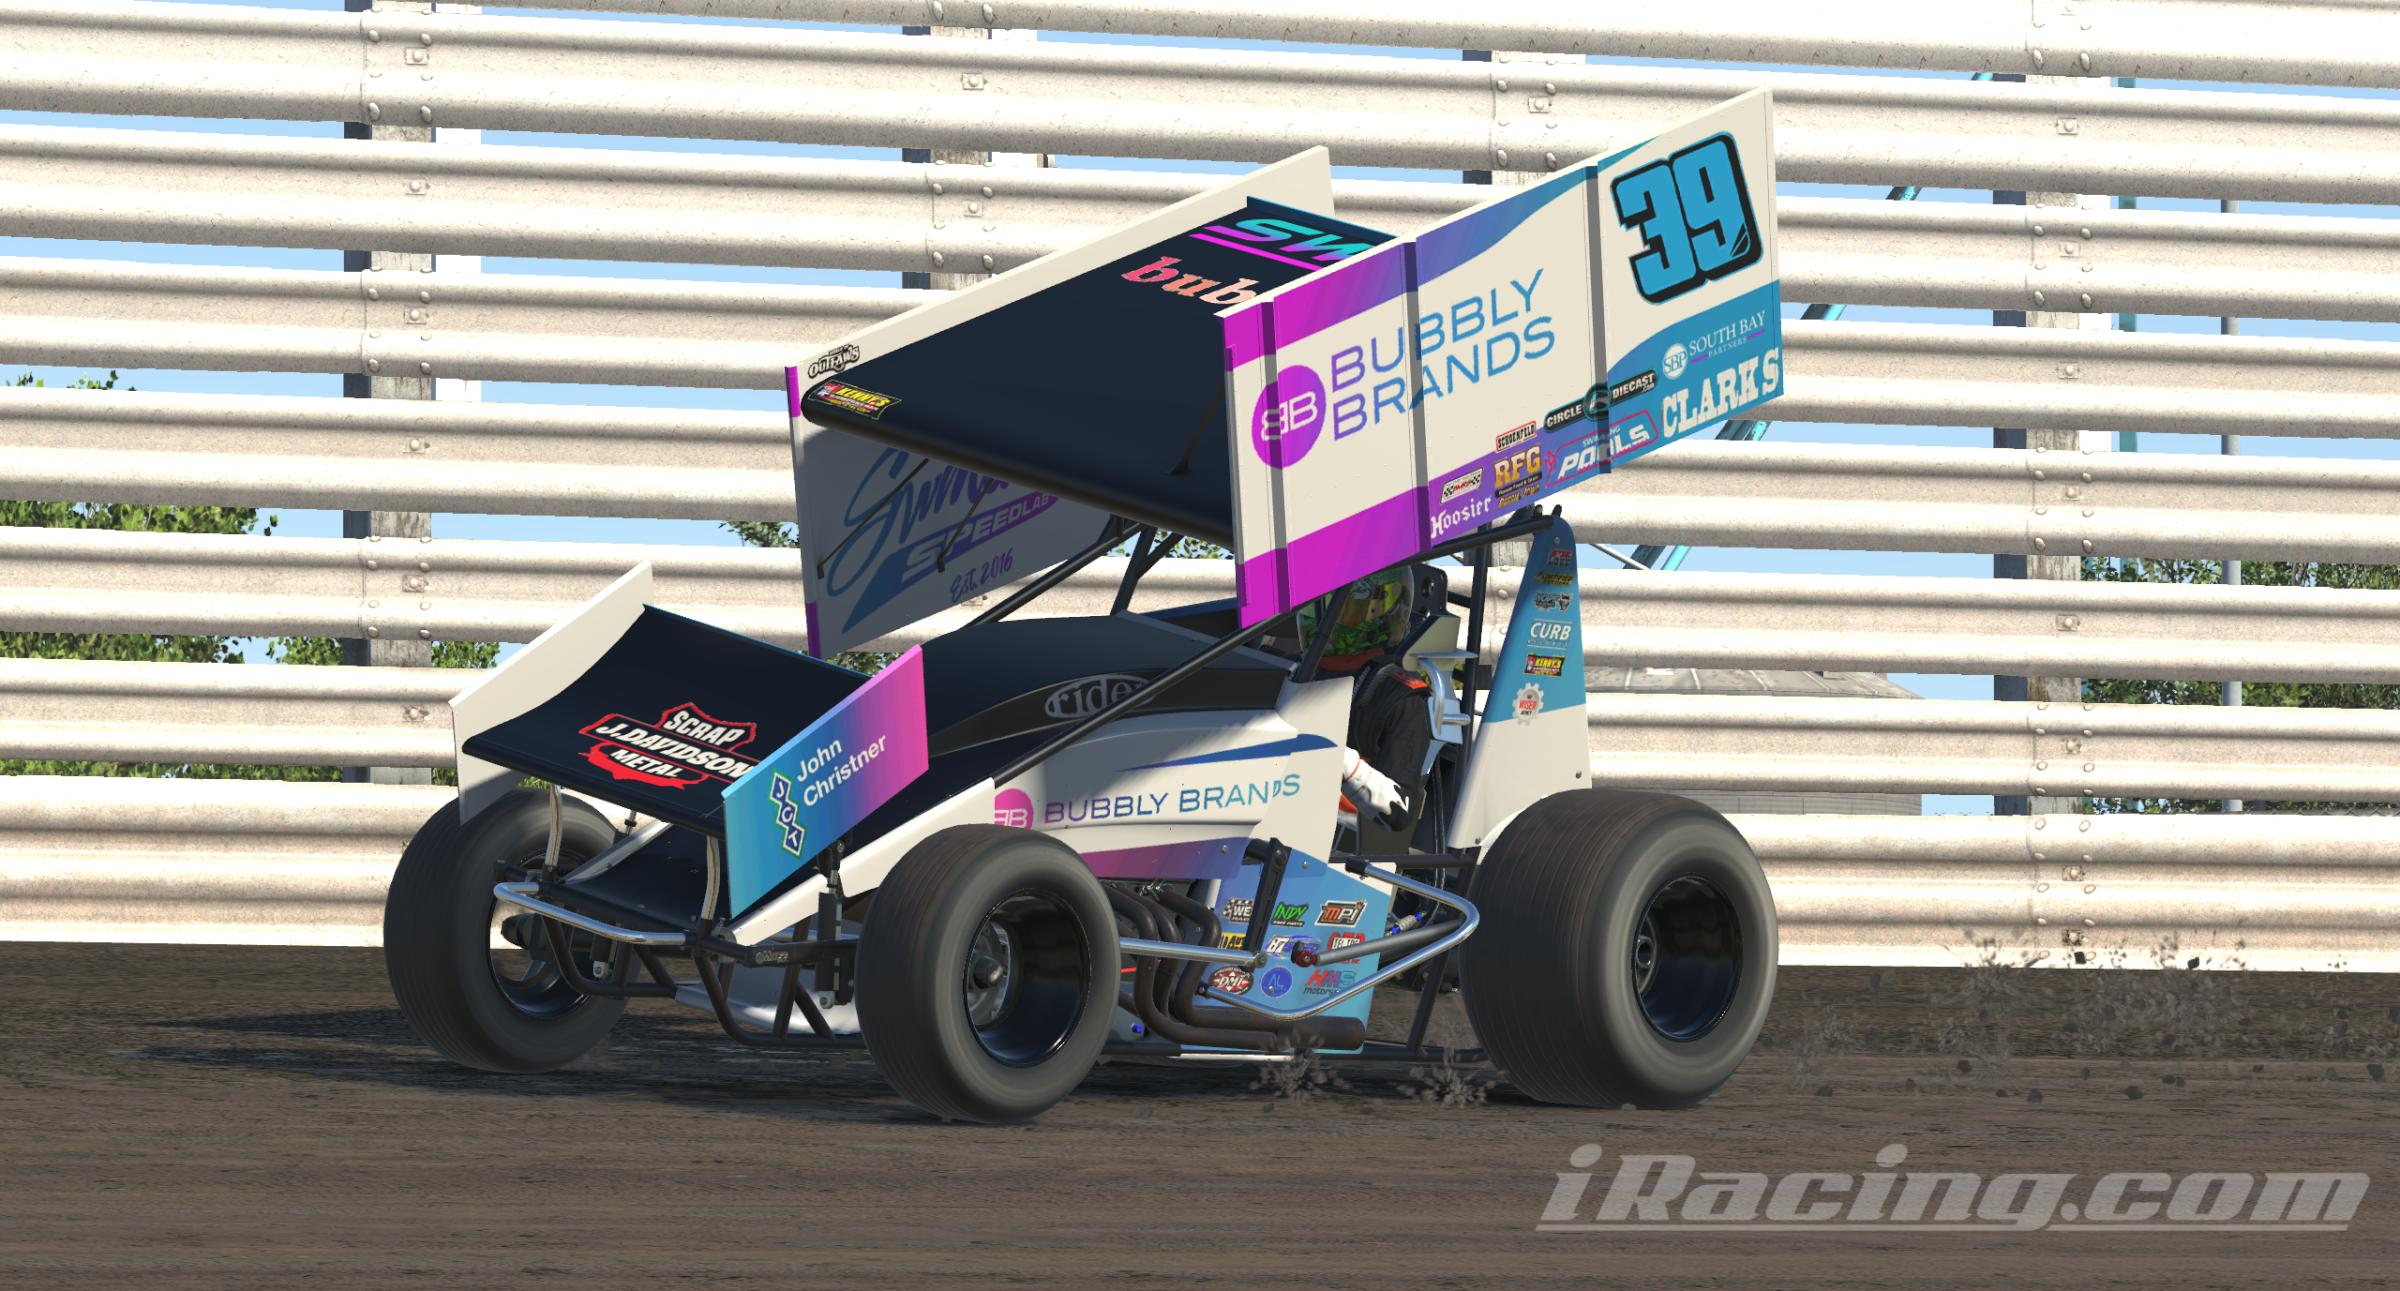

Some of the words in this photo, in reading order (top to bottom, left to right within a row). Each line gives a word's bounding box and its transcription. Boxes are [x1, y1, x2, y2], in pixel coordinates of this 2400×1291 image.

[1611, 134, 1762, 303] 39
[1331, 268, 1544, 393] BUBBLY
[1688, 324, 1737, 356] SOUTH
[1739, 310, 1766, 336] BAY
[1708, 337, 1748, 358] PARTNERS
[808, 346, 861, 379] OUTLAWS
[1332, 316, 1555, 441] BRANDS
[1546, 404, 1582, 428] CIRCLE
[1612, 373, 1655, 399] DIECAST
[1662, 347, 1780, 438] CLARKS
[1494, 444, 1541, 488] RFG
[902, 493, 1050, 580] SPEEDLAB
[1430, 497, 1492, 539] Hoosier
[950, 573, 977, 602] Est.
[980, 547, 1014, 585] 2016
[1530, 622, 1571, 640] CURB
[595, 723, 756, 779] J.DAVIDSON
[663, 710, 745, 745] SCRAP
[610, 748, 684, 778] METAL
[796, 738, 842, 783] John
[803, 734, 888, 807] Christner
[1044, 792, 1168, 824] BUBBLY
[1179, 773, 1301, 813] BRANDS
[1274, 901, 1309, 921] INDY
